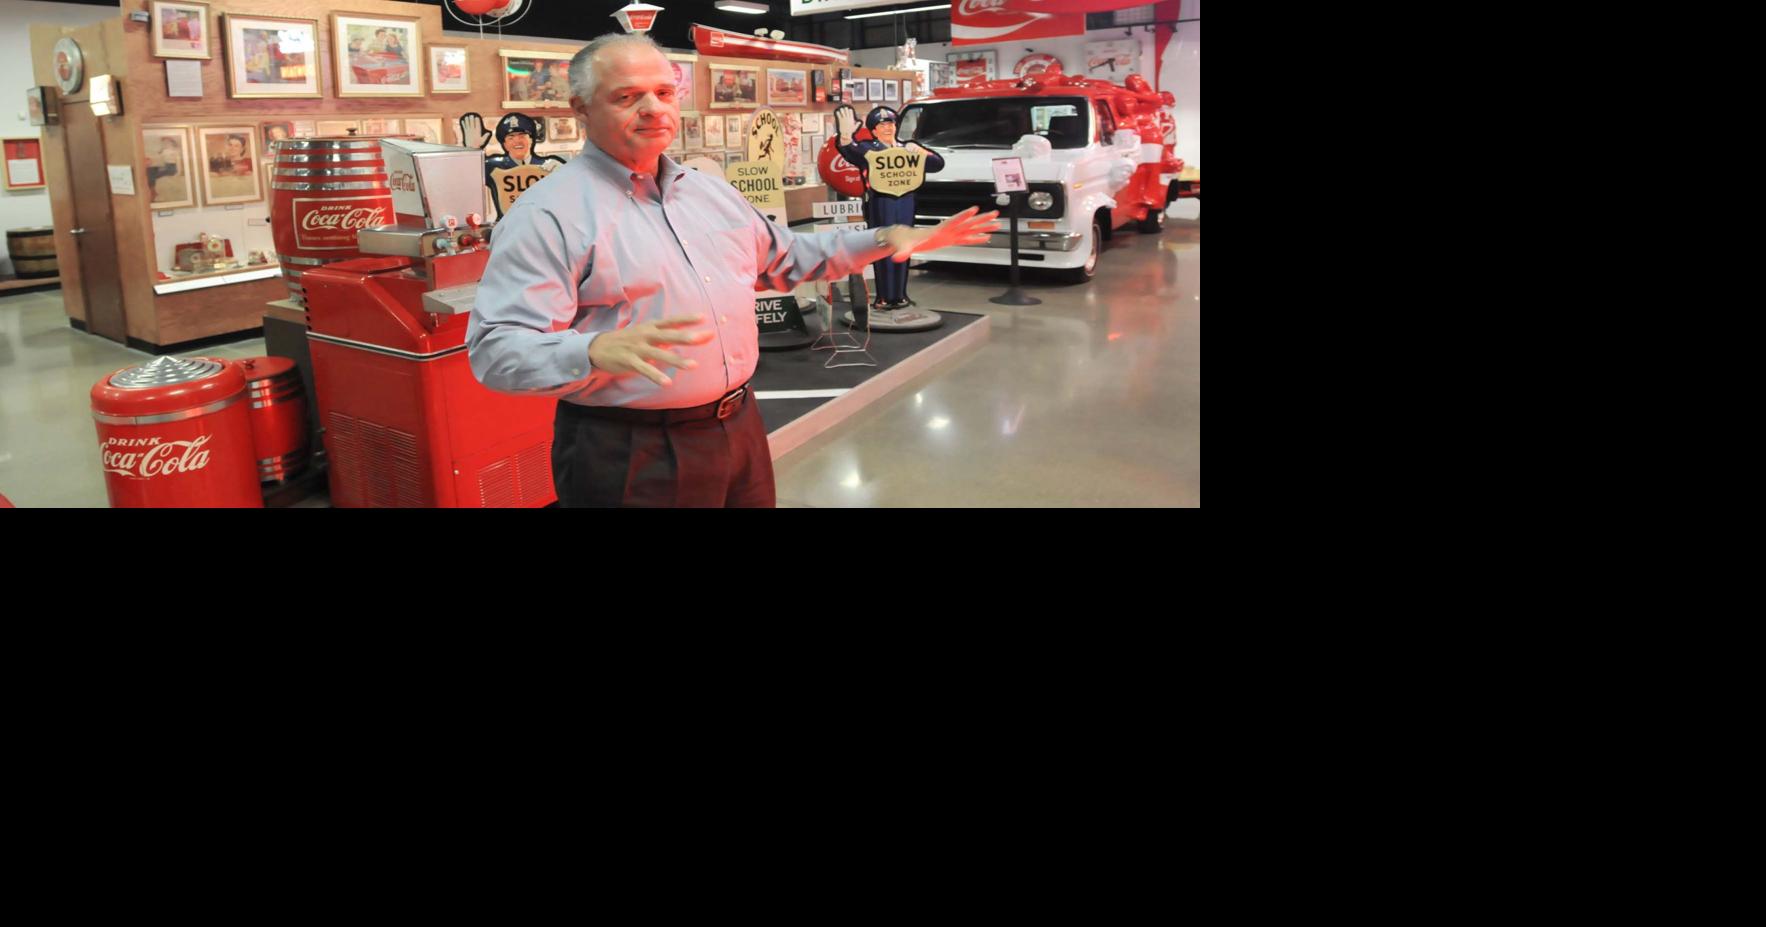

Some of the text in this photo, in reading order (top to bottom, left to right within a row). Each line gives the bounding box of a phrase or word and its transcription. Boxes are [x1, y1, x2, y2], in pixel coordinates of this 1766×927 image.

[751, 112, 780, 136] SCHOOL
[875, 154, 920, 170] SLOW
[737, 166, 769, 177] SLOW
[879, 170, 918, 179] SCHOOL
[503, 174, 545, 192] SLO
[730, 177, 779, 193] SCHOOL
[888, 179, 911, 187] ZONE
[743, 194, 770, 204] ONE
[823, 203, 863, 216] LUBRI
[302, 206, 386, 231] Coca-Cola
[755, 299, 783, 312] RIVE
[755, 311, 787, 325] FELY
[108, 437, 162, 447] DRINK
[101, 434, 213, 477] Coca-Cola
